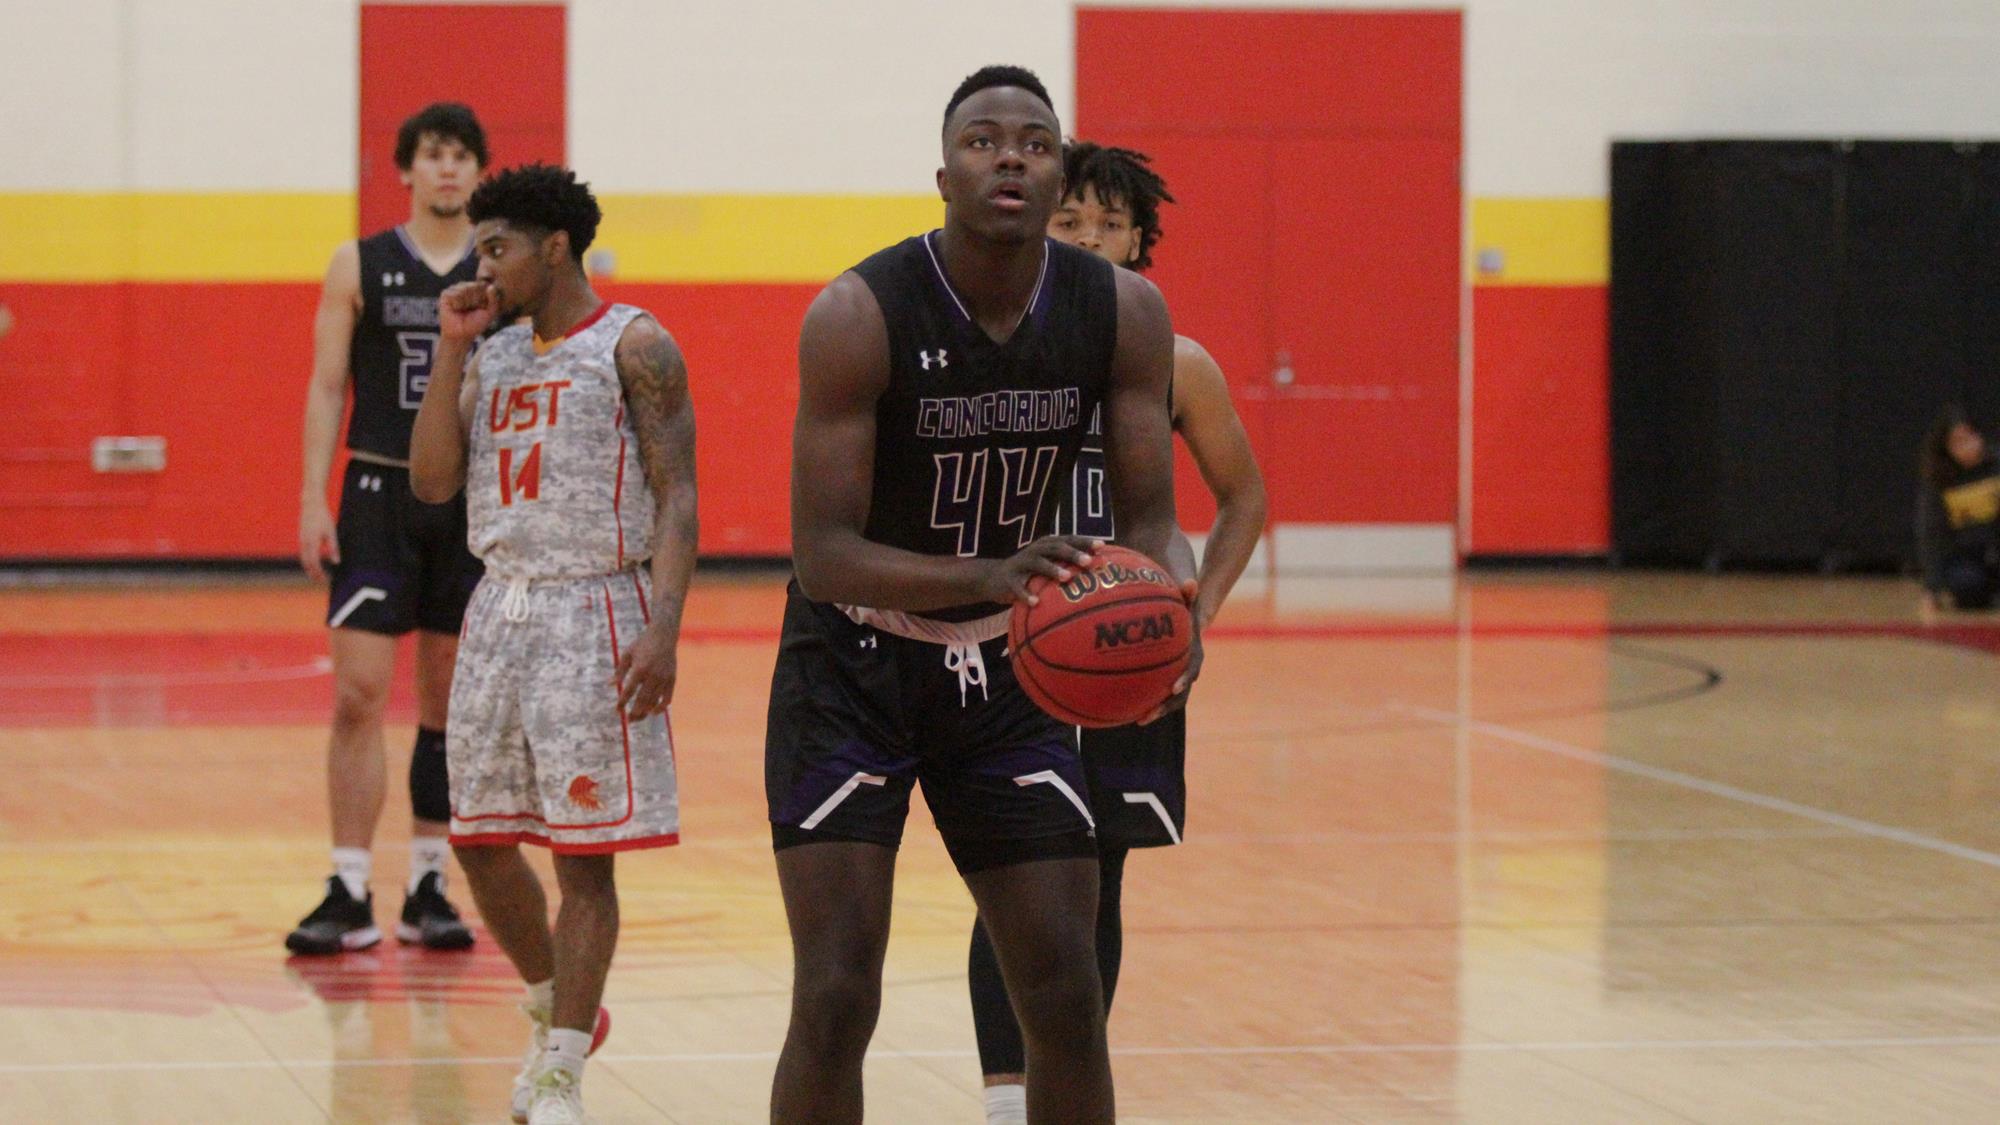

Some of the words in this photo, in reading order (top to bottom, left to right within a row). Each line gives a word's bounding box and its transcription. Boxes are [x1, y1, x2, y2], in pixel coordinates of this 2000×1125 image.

[490, 380, 571, 433] UST
[916, 387, 1080, 438] CONCORDIA
[499, 441, 541, 506] 14
[931, 446, 1058, 556] 44
[1059, 560, 1168, 602] Wilson
[1094, 613, 1174, 649] NCAA
